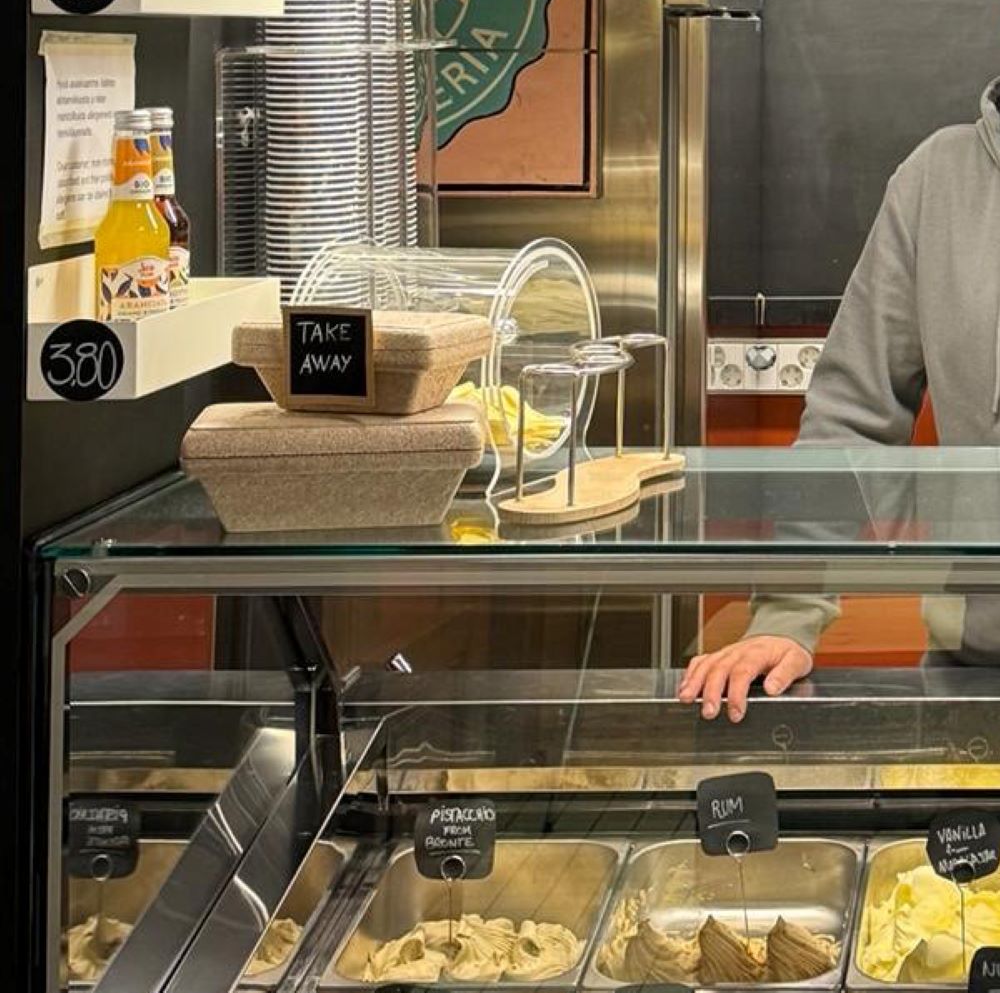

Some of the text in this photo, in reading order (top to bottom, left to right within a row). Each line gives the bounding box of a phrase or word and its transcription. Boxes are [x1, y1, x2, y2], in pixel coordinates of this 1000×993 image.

[296, 320, 352, 345] TAKE
[299, 353, 352, 375] AWAY
[711, 796, 744, 819] RUM
